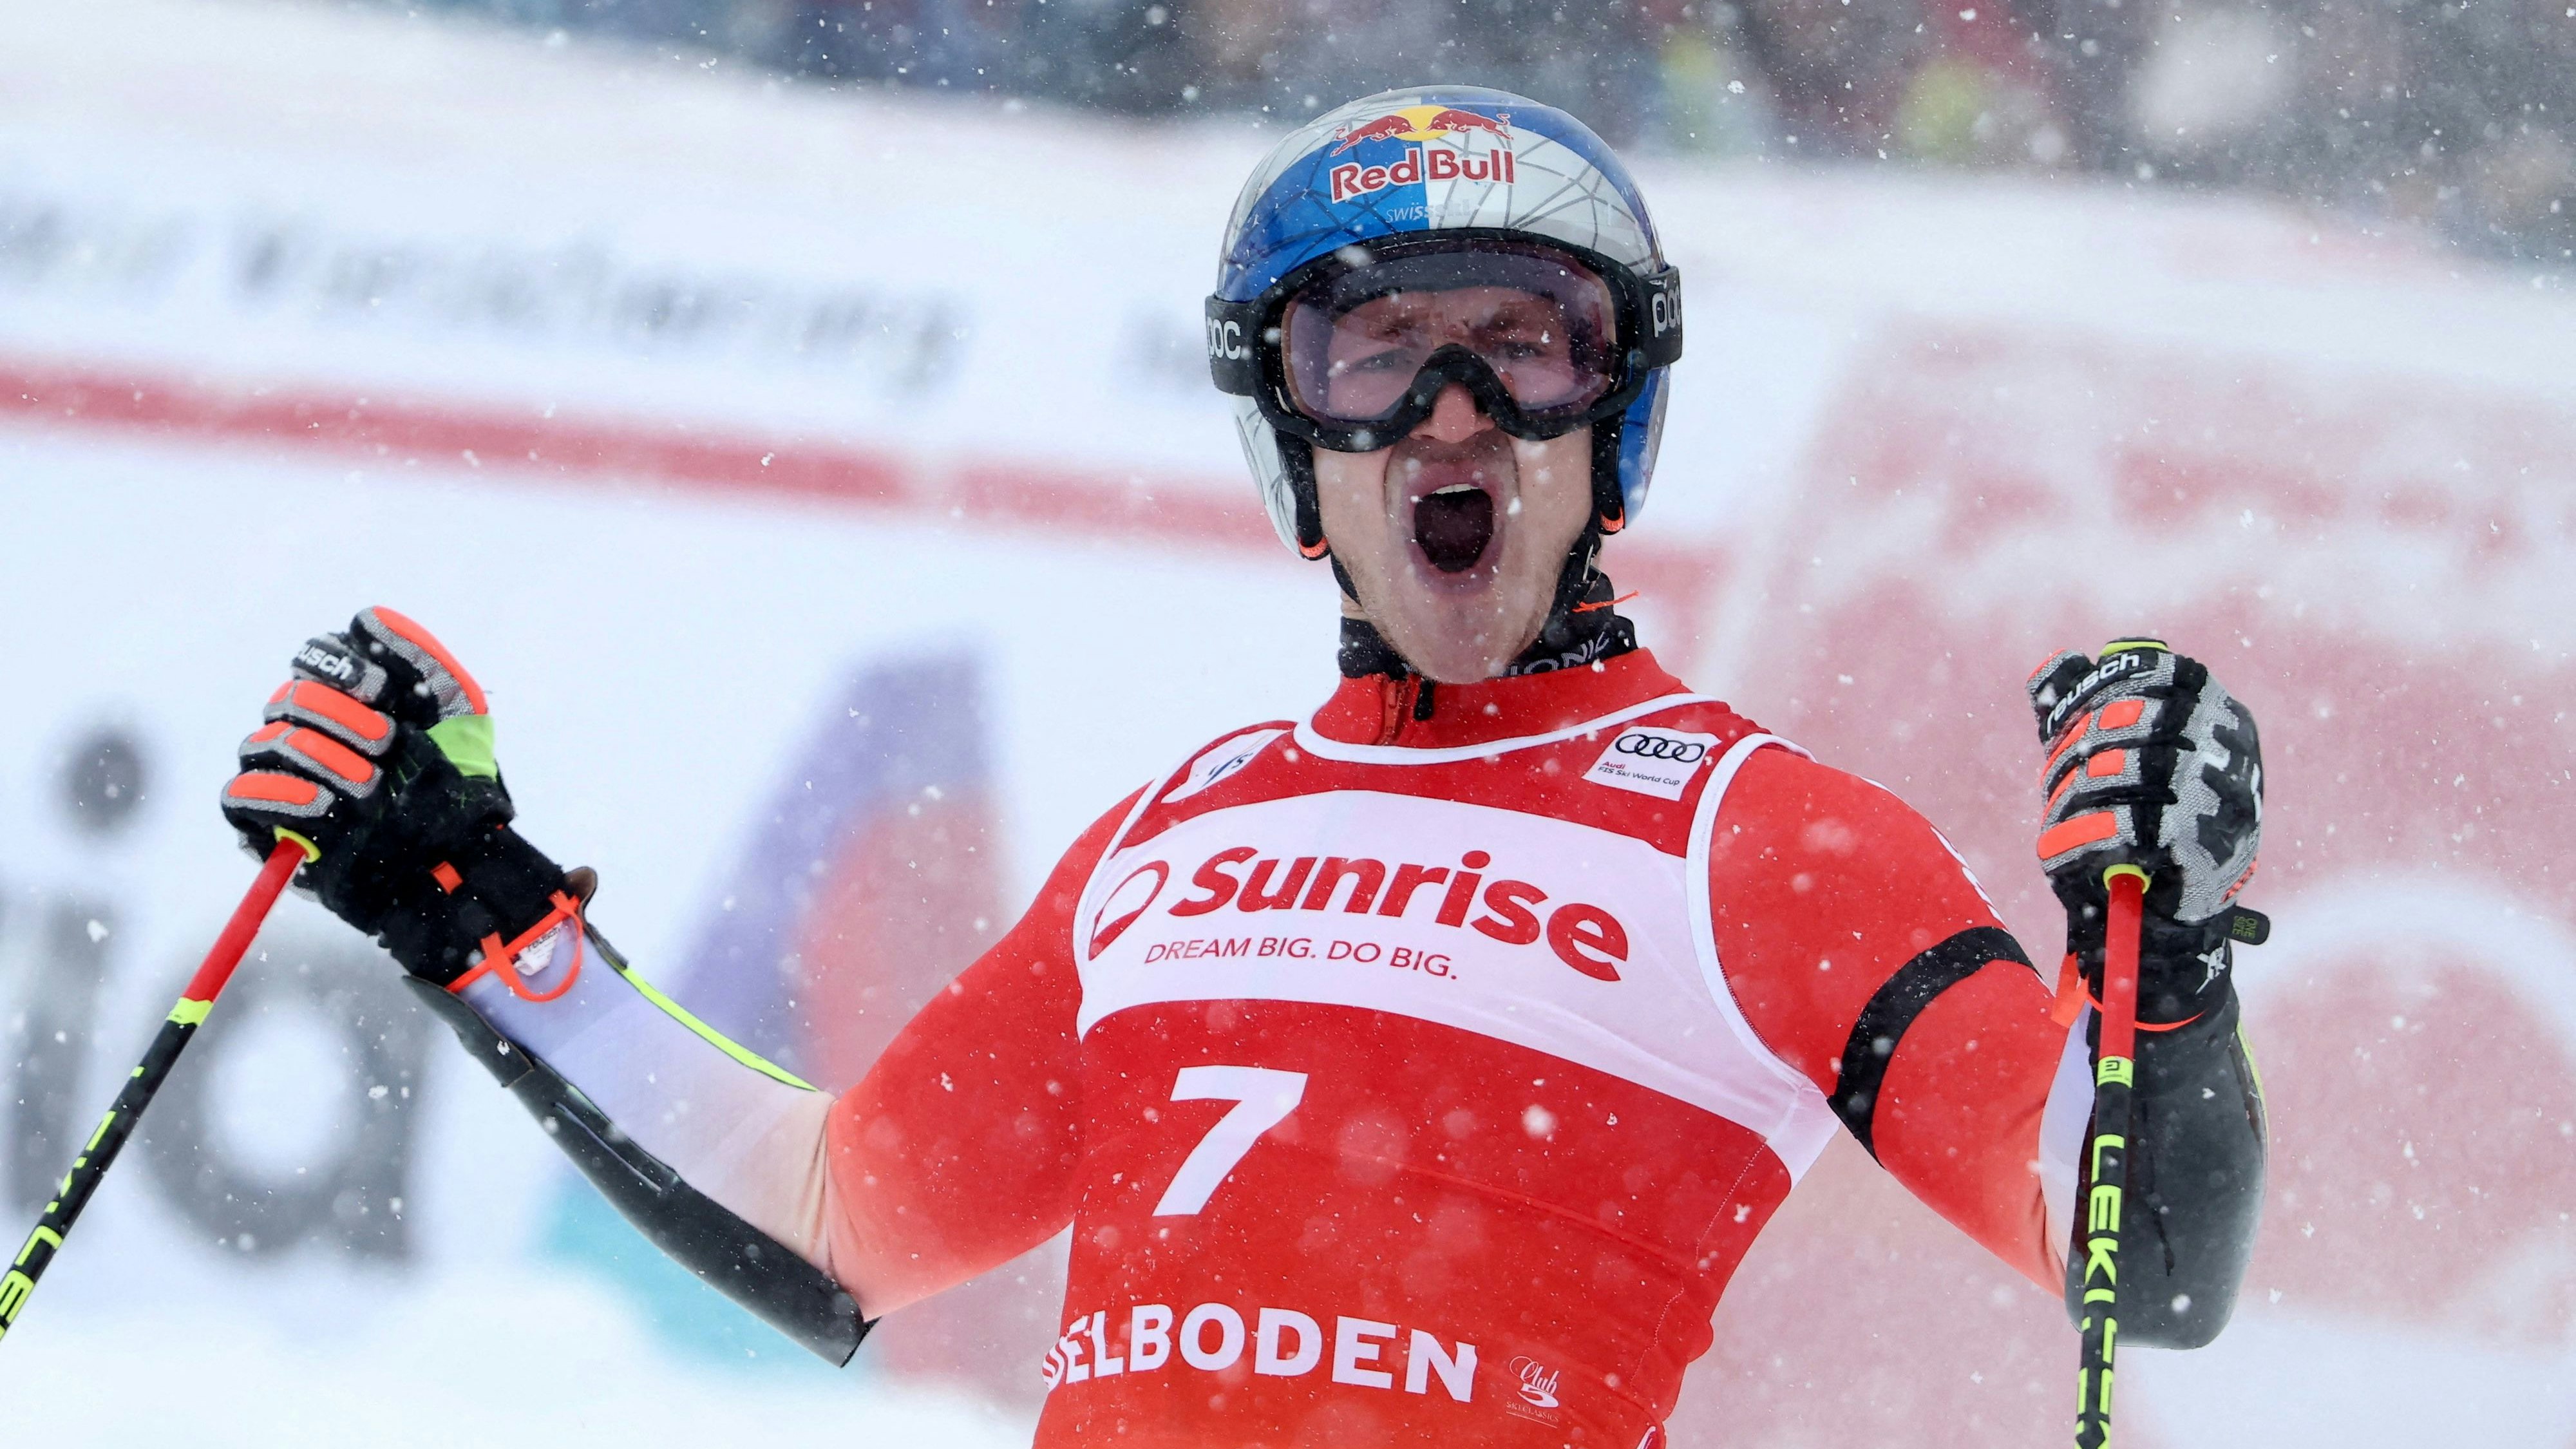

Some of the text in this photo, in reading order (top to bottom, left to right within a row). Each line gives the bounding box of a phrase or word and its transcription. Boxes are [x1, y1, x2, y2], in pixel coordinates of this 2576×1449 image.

[1331, 149, 1514, 202] Red Bull
[2047, 653, 2140, 737] reusch
[1602, 761, 1625, 770] Audi
[1615, 767, 1631, 777] Ski
[1631, 772, 1661, 783] World
[1663, 778, 1680, 786] Cup
[1168, 847, 1629, 982] Sunrise
[1144, 936, 1457, 980] DREAM BIG. DO BIG.
[1152, 1065, 1308, 1217] 7
[2083, 1133, 2125, 1304] LEKI
